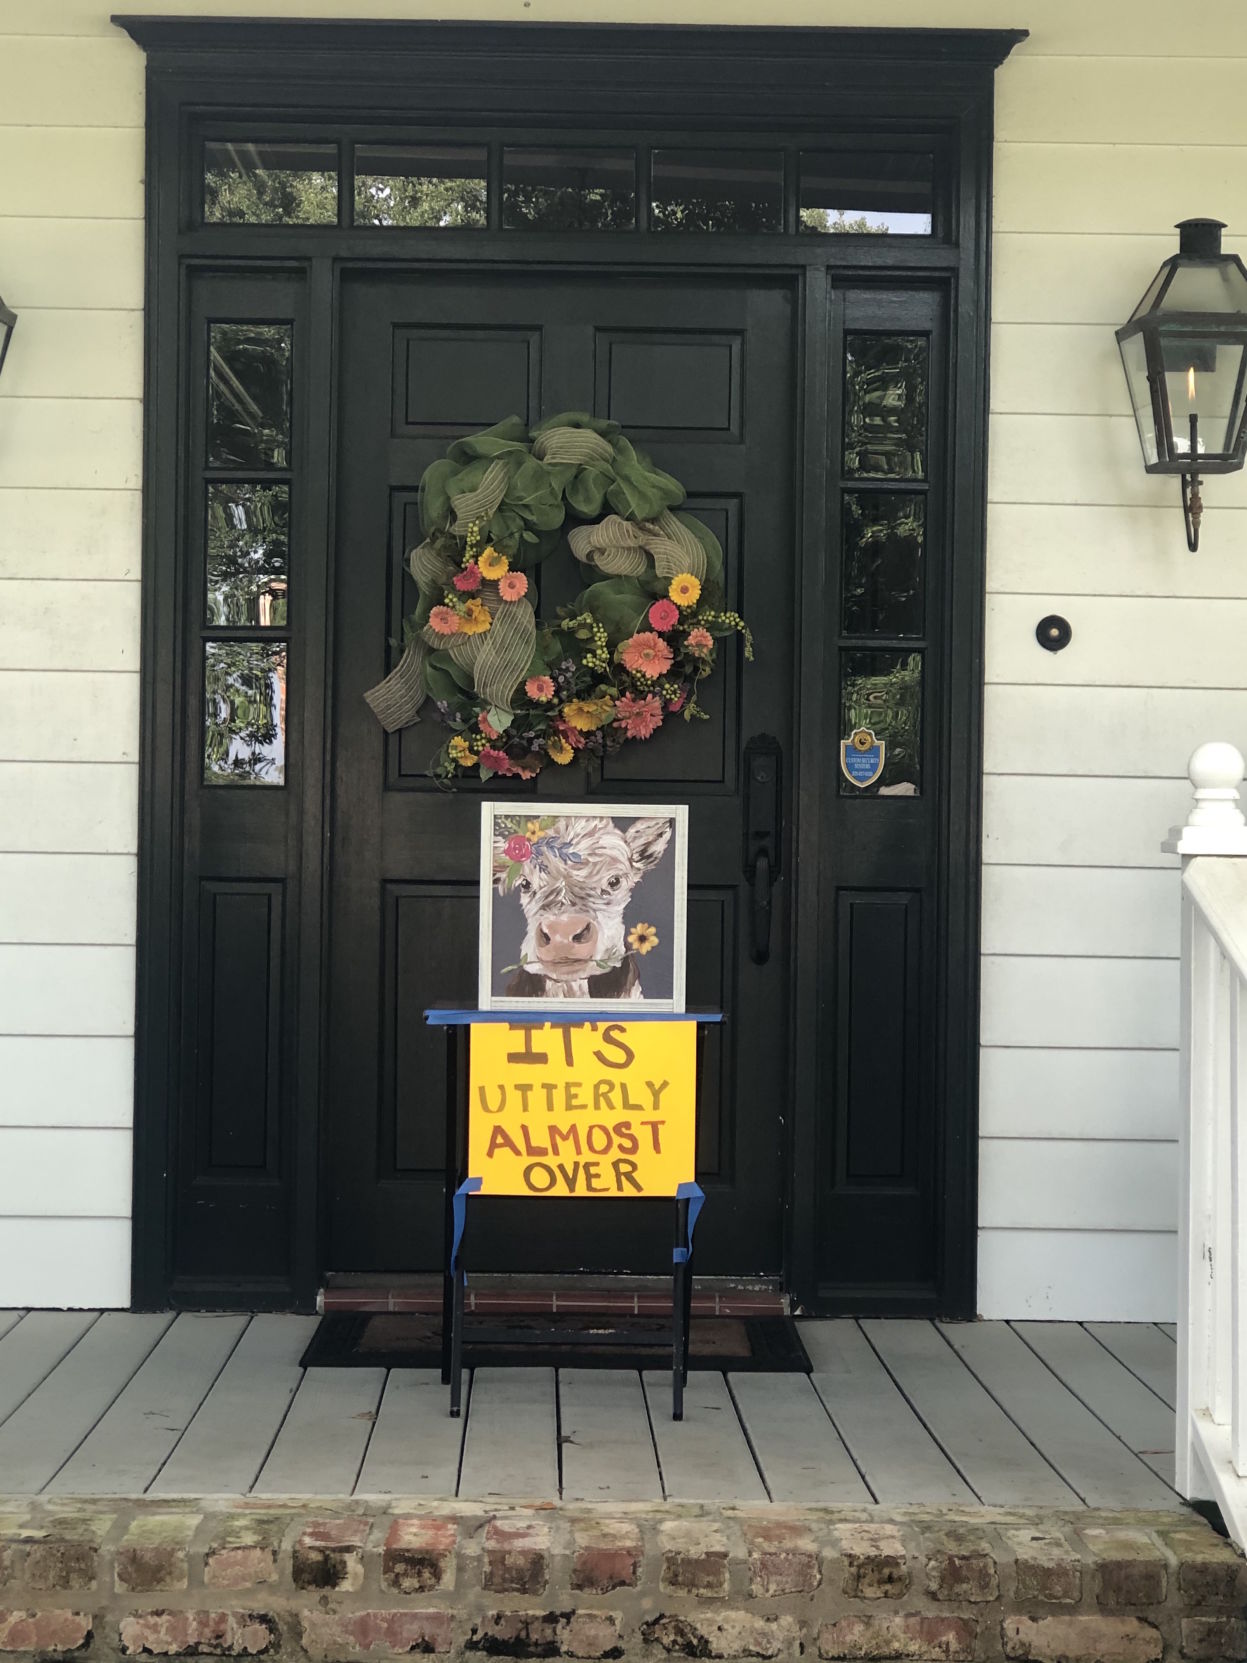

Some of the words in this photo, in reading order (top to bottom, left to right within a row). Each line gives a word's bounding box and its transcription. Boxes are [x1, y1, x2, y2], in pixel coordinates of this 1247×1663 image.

[506, 1022, 635, 1070] IT'S
[478, 1079, 670, 1113] UTTERLY
[486, 1120, 666, 1159] ALMOST
[523, 1158, 644, 1194] OVER
